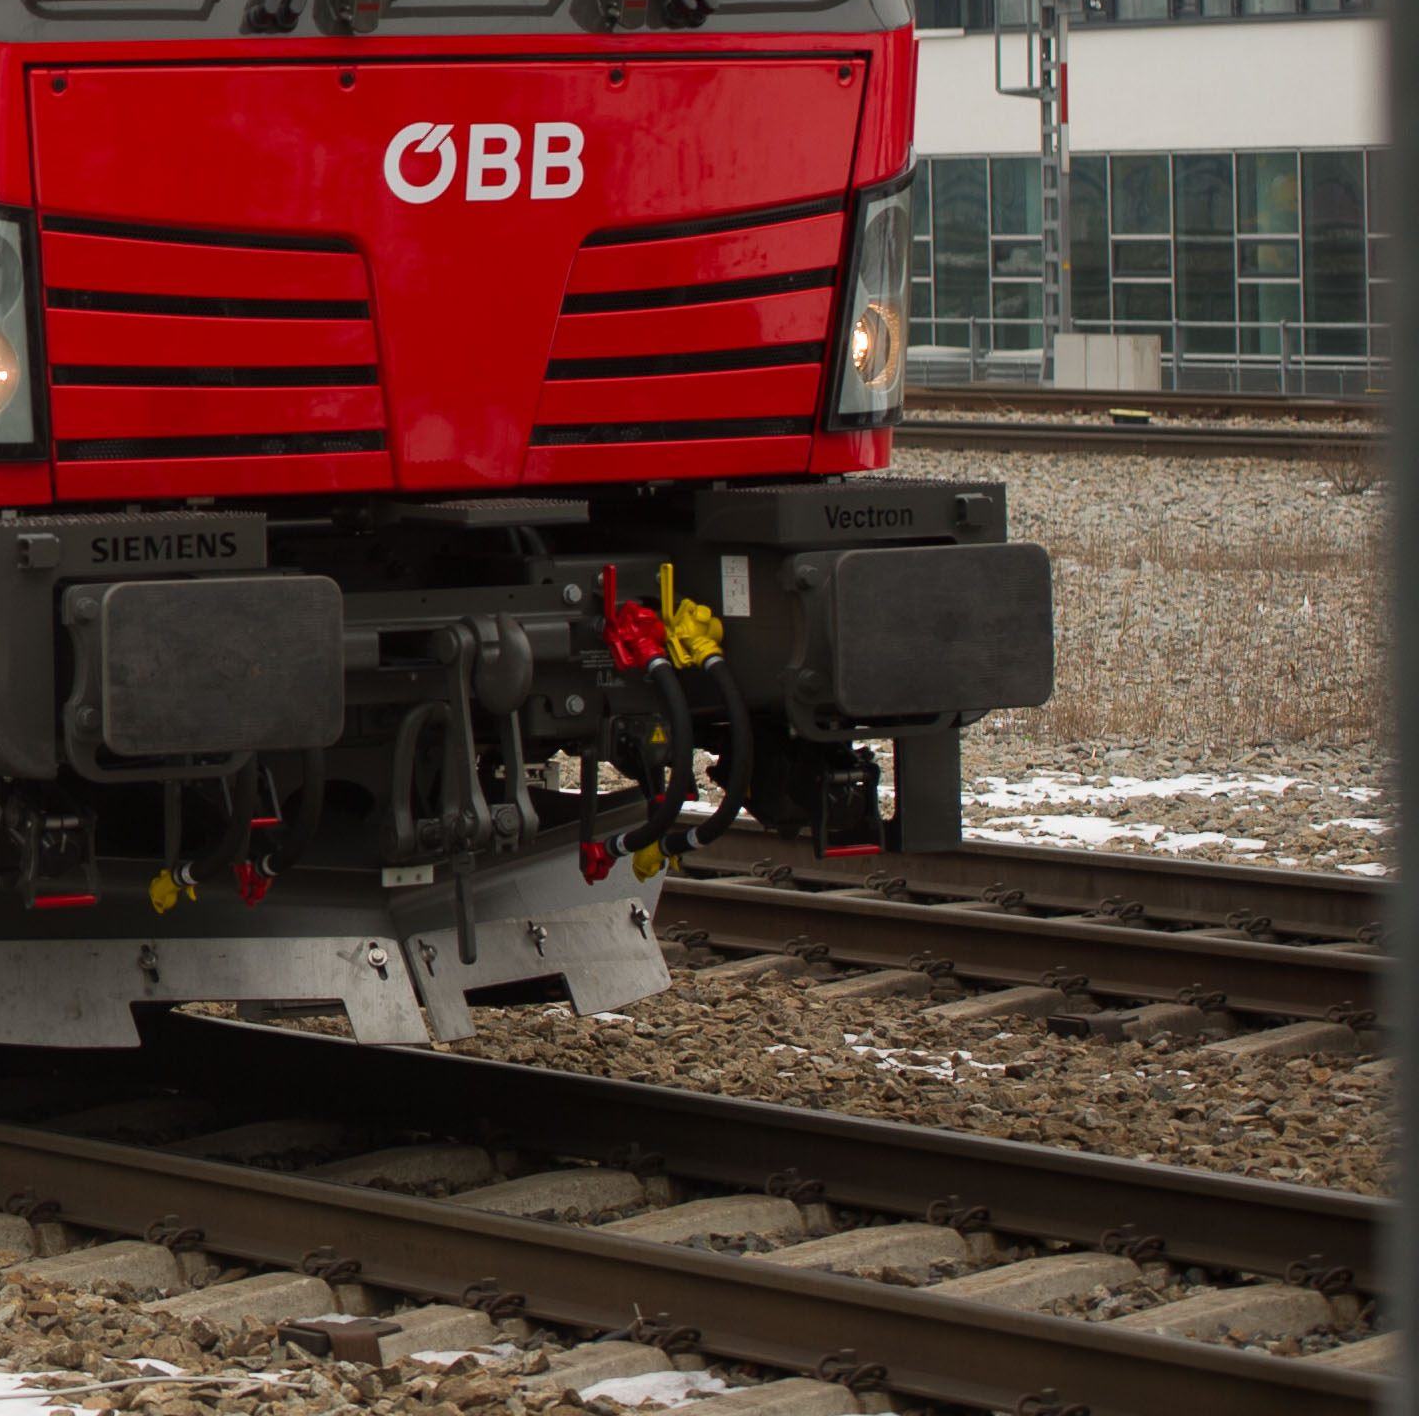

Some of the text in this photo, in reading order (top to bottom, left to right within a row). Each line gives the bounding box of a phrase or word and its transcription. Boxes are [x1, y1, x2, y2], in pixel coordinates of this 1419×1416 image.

[383, 122, 585, 204] ÖBB
[824, 504, 914, 529] Vectron
[91, 532, 237, 564] SIEMENS
